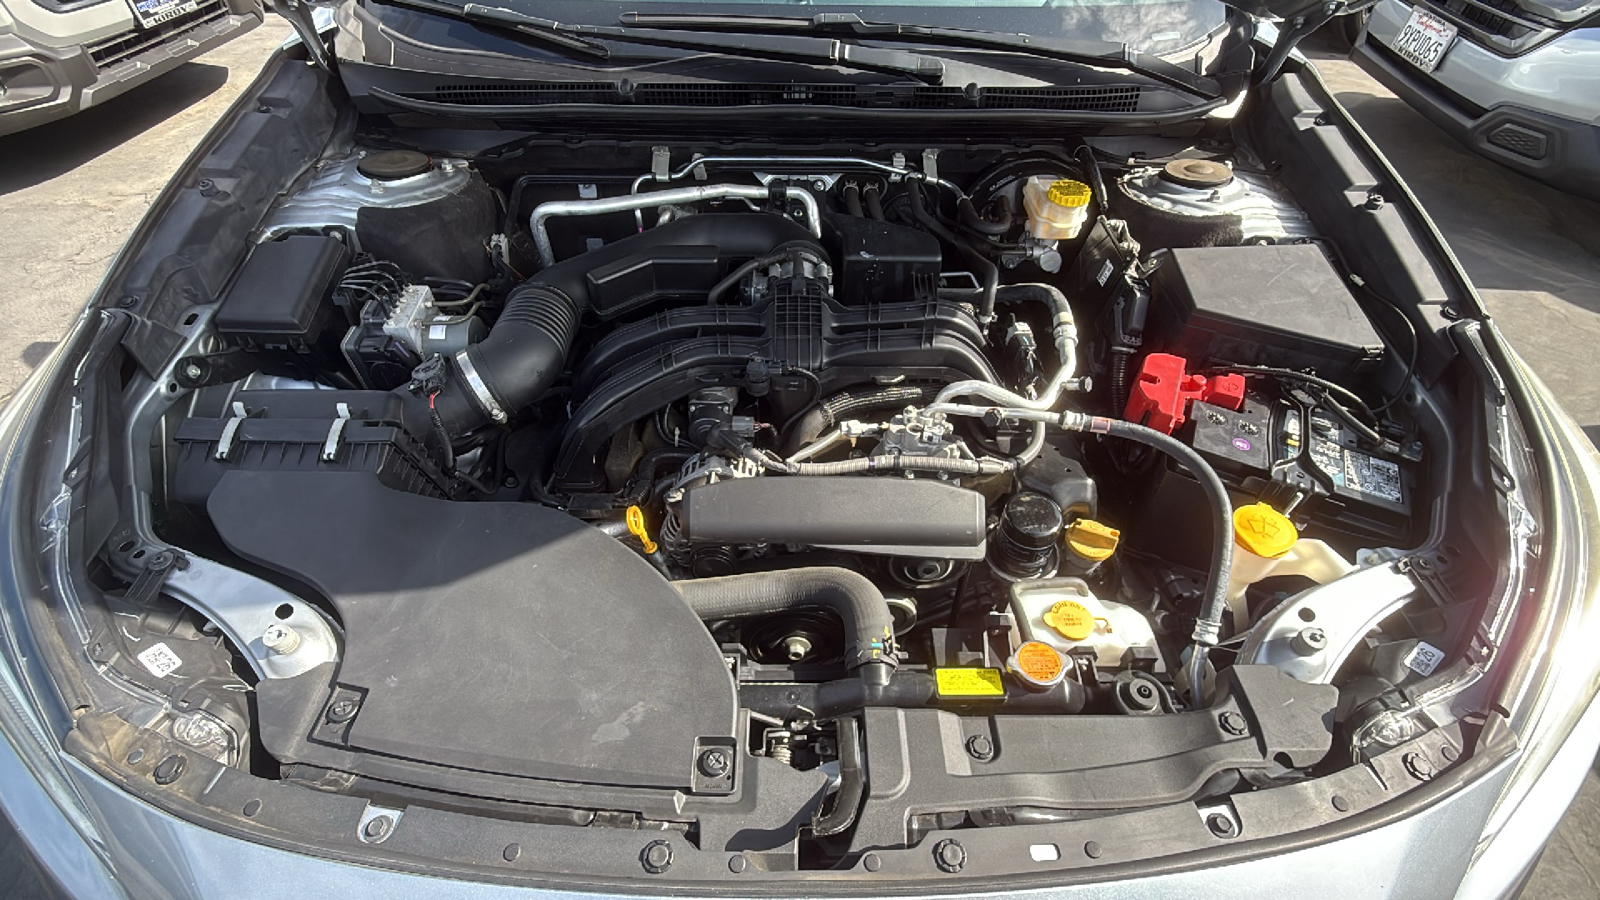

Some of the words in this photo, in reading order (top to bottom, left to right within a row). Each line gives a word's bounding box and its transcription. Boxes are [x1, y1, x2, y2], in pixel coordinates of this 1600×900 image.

[153, 5, 187, 24] KIRBY
[1398, 24, 1444, 63] 9XPU065
[1397, 46, 1426, 67] KIRBY
